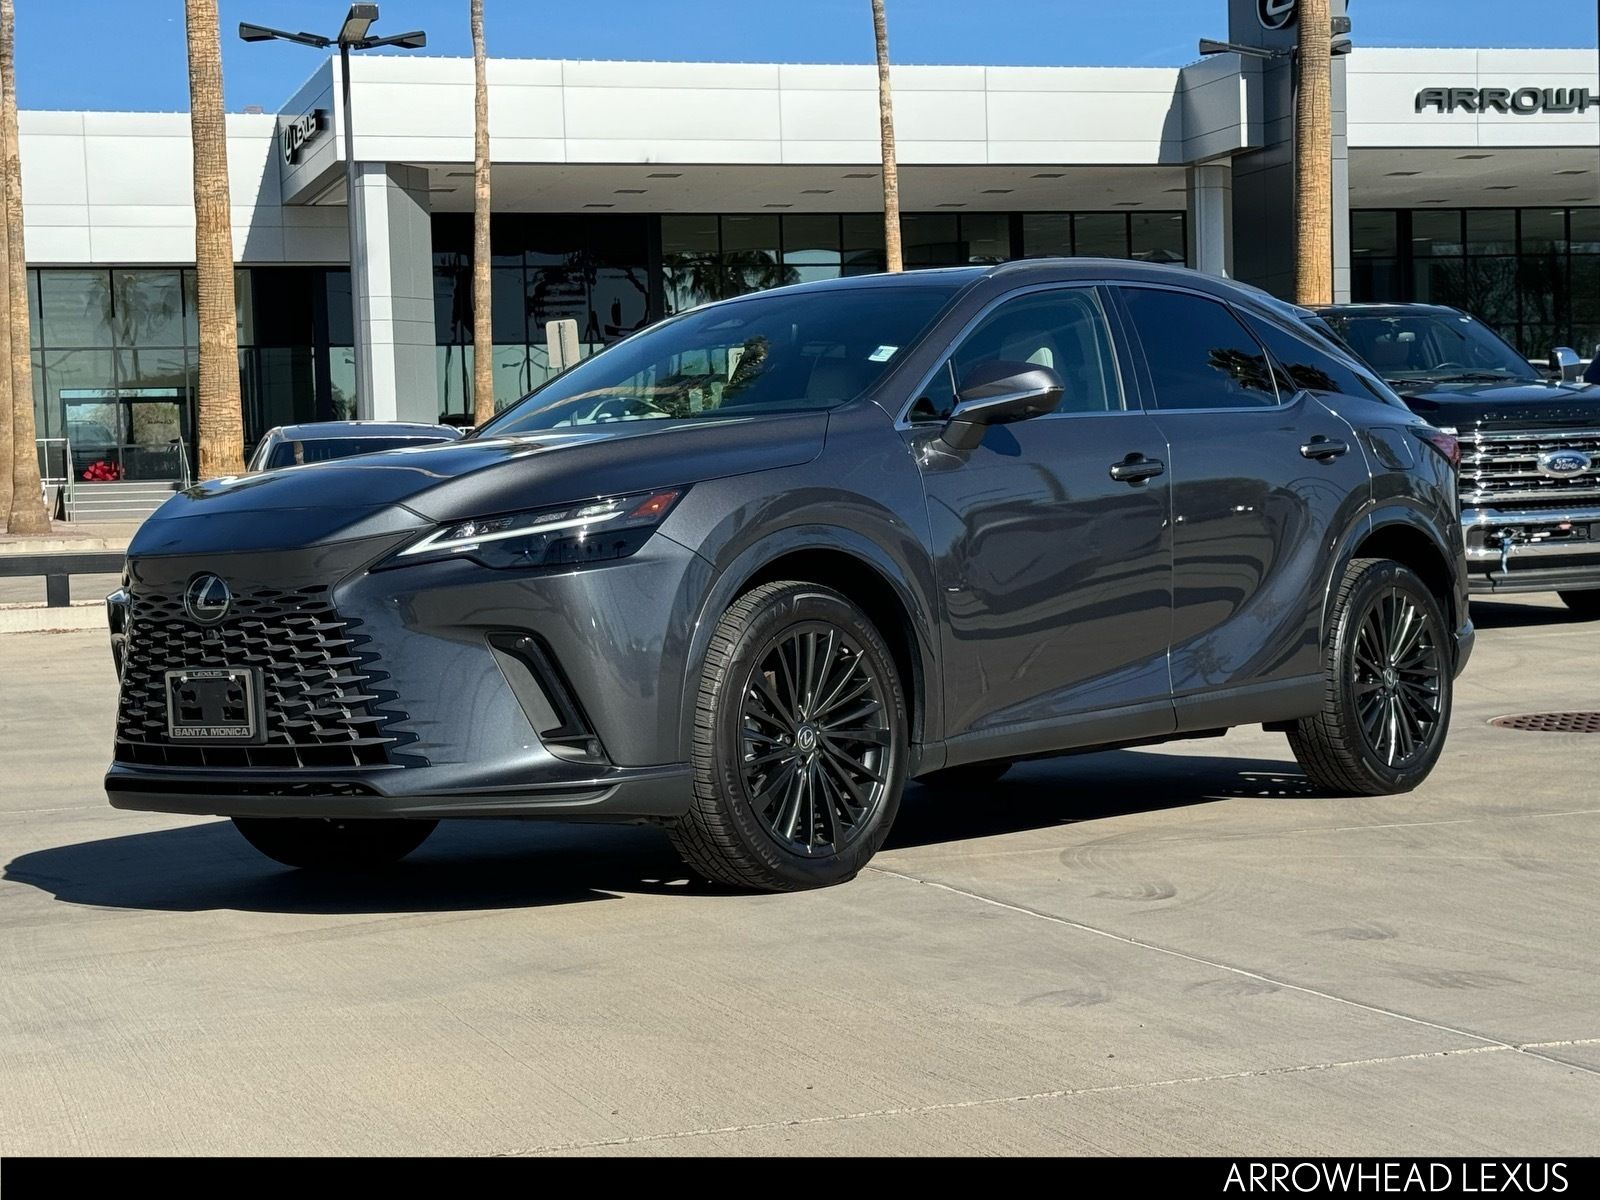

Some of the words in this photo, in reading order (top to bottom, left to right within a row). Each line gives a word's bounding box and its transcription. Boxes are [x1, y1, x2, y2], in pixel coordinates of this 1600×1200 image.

[1554, 457, 1579, 470] Ford
[174, 728, 208, 736] SANTA
[210, 727, 249, 736] MONICA
[724, 759, 782, 869] BRIDGESTONE
